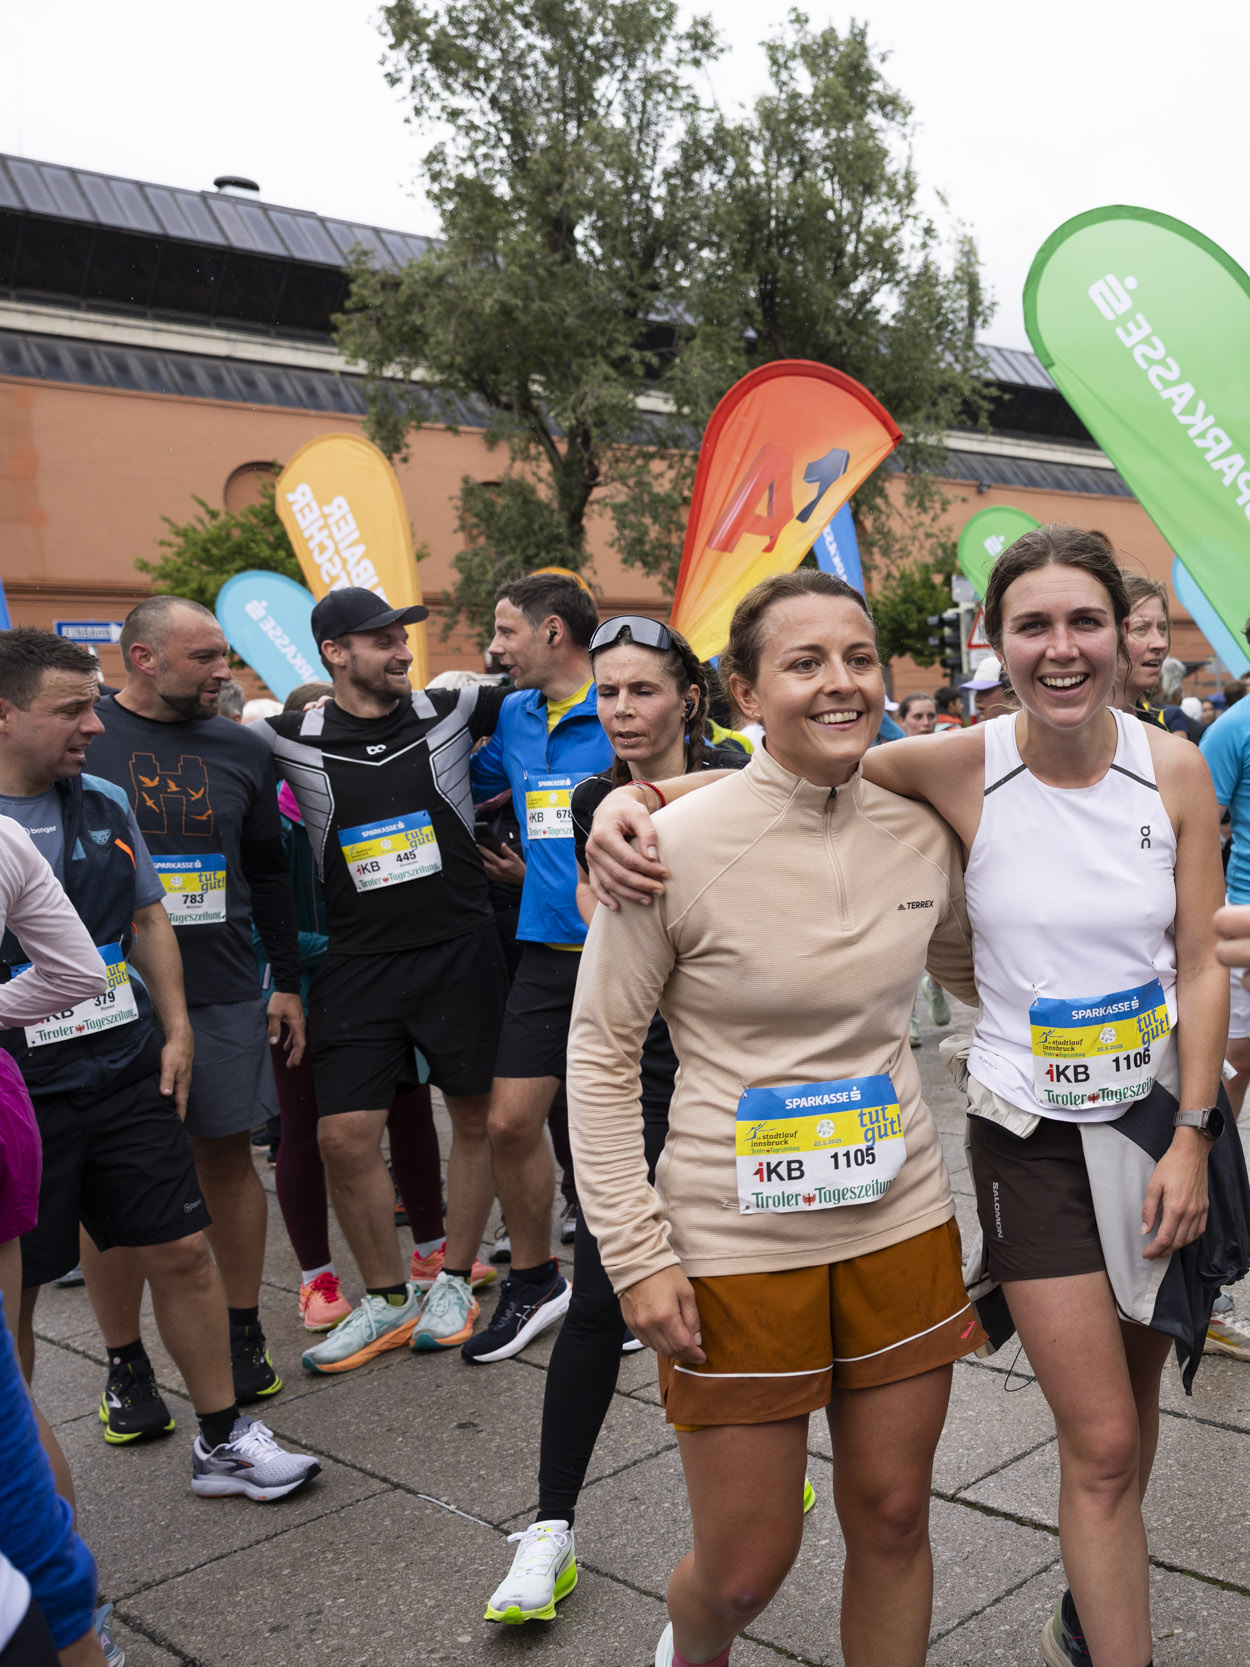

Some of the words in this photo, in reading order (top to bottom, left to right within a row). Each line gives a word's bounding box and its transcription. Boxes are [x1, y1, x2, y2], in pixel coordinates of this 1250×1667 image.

[706, 442, 850, 554] A1
[556, 810, 573, 819] 678
[30, 826, 57, 834] benger
[362, 823, 398, 838] SPARKASSE
[404, 827, 427, 842] tut
[409, 830, 435, 851] gut!
[396, 850, 417, 863] 445
[198, 872, 218, 883] tut
[201, 876, 225, 894] gut!
[359, 878, 381, 890] Tiroler
[387, 862, 439, 881] Tageszeitung
[182, 894, 204, 904] 783
[907, 900, 934, 910] TERREX
[168, 911, 222, 924] Tageszeitung
[108, 970, 129, 992] gut!
[94, 991, 116, 1007] 379
[1072, 1002, 1130, 1020] SPARKASSE
[1137, 1008, 1159, 1032] tut
[36, 1025, 74, 1042] Tiroler
[83, 1008, 135, 1030] Tageszeitung
[1142, 1013, 1170, 1050] gut!
[1112, 1049, 1151, 1072] 1106
[1045, 1064, 1090, 1083] iKB
[785, 1091, 849, 1110] SPARKASSE
[1044, 1089, 1087, 1106] Tiroler
[857, 1105, 890, 1128] tut
[762, 1131, 798, 1139] stadtlauf
[864, 1114, 902, 1147] gut!
[751, 1139, 789, 1147] innsbruck
[813, 1138, 842, 1147] 25.5.2025
[830, 1147, 876, 1170] 1105
[753, 1159, 805, 1183] iKB
[751, 1191, 801, 1209] Tiroler
[814, 1178, 896, 1205] Tageszeitun
[992, 1181, 1004, 1239] SALOMON
